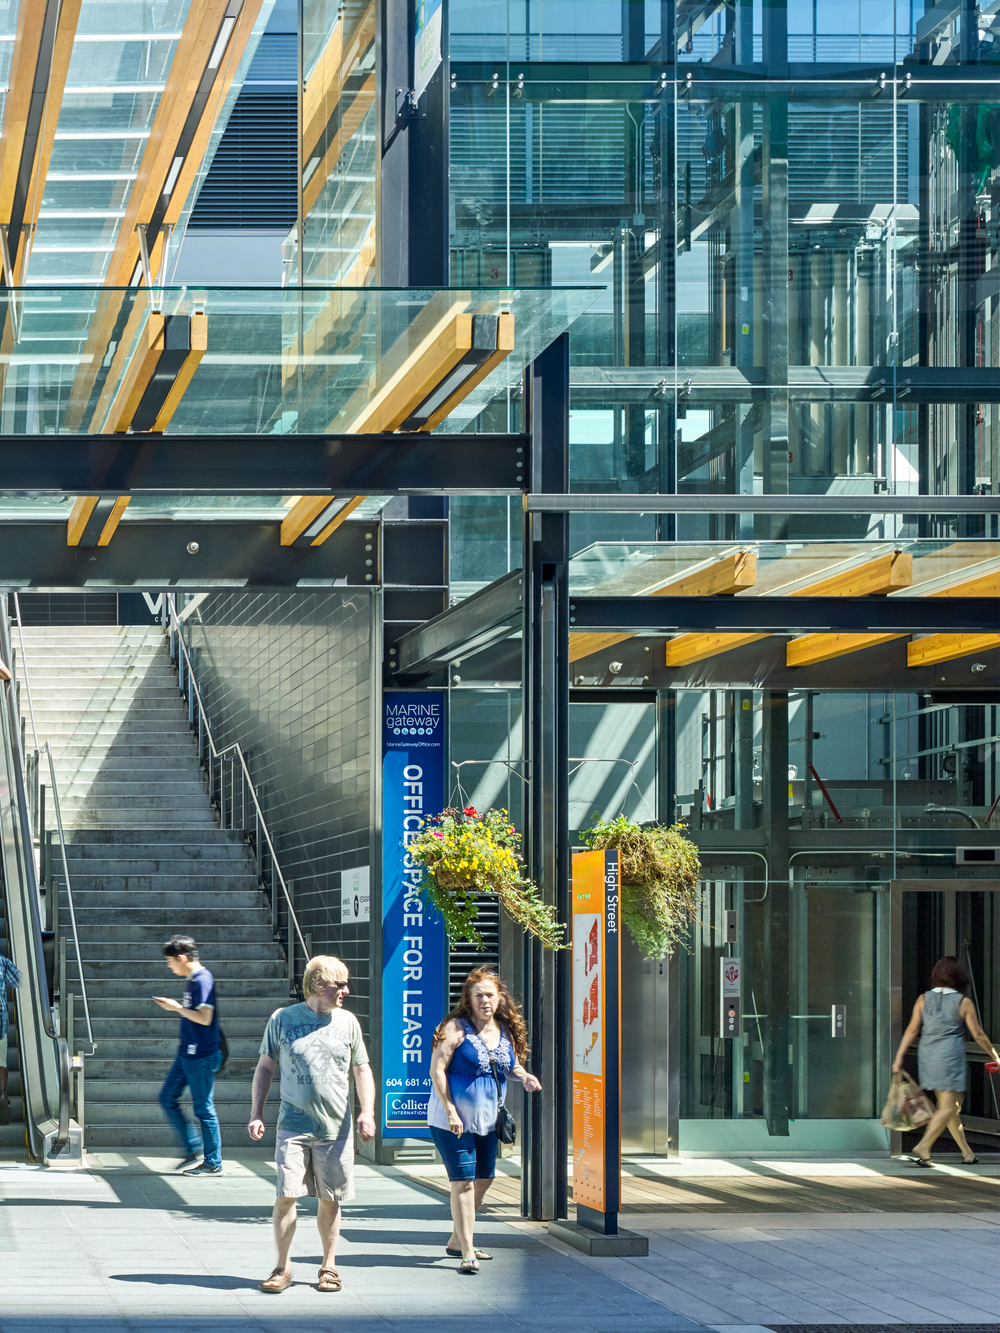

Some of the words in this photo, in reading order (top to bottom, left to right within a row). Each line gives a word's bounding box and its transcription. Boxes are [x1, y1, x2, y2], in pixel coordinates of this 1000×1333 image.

[386, 704, 440, 716] MARINE
[386, 715, 440, 729] gateway
[604, 862, 619, 891] High
[607, 895, 619, 933] Street
[402, 936, 423, 982] FOR
[402, 990, 423, 1063] LEASE
[386, 1078, 403, 1087] 604
[405, 1078, 420, 1087] 681
[422, 1078, 432, 1087] 41
